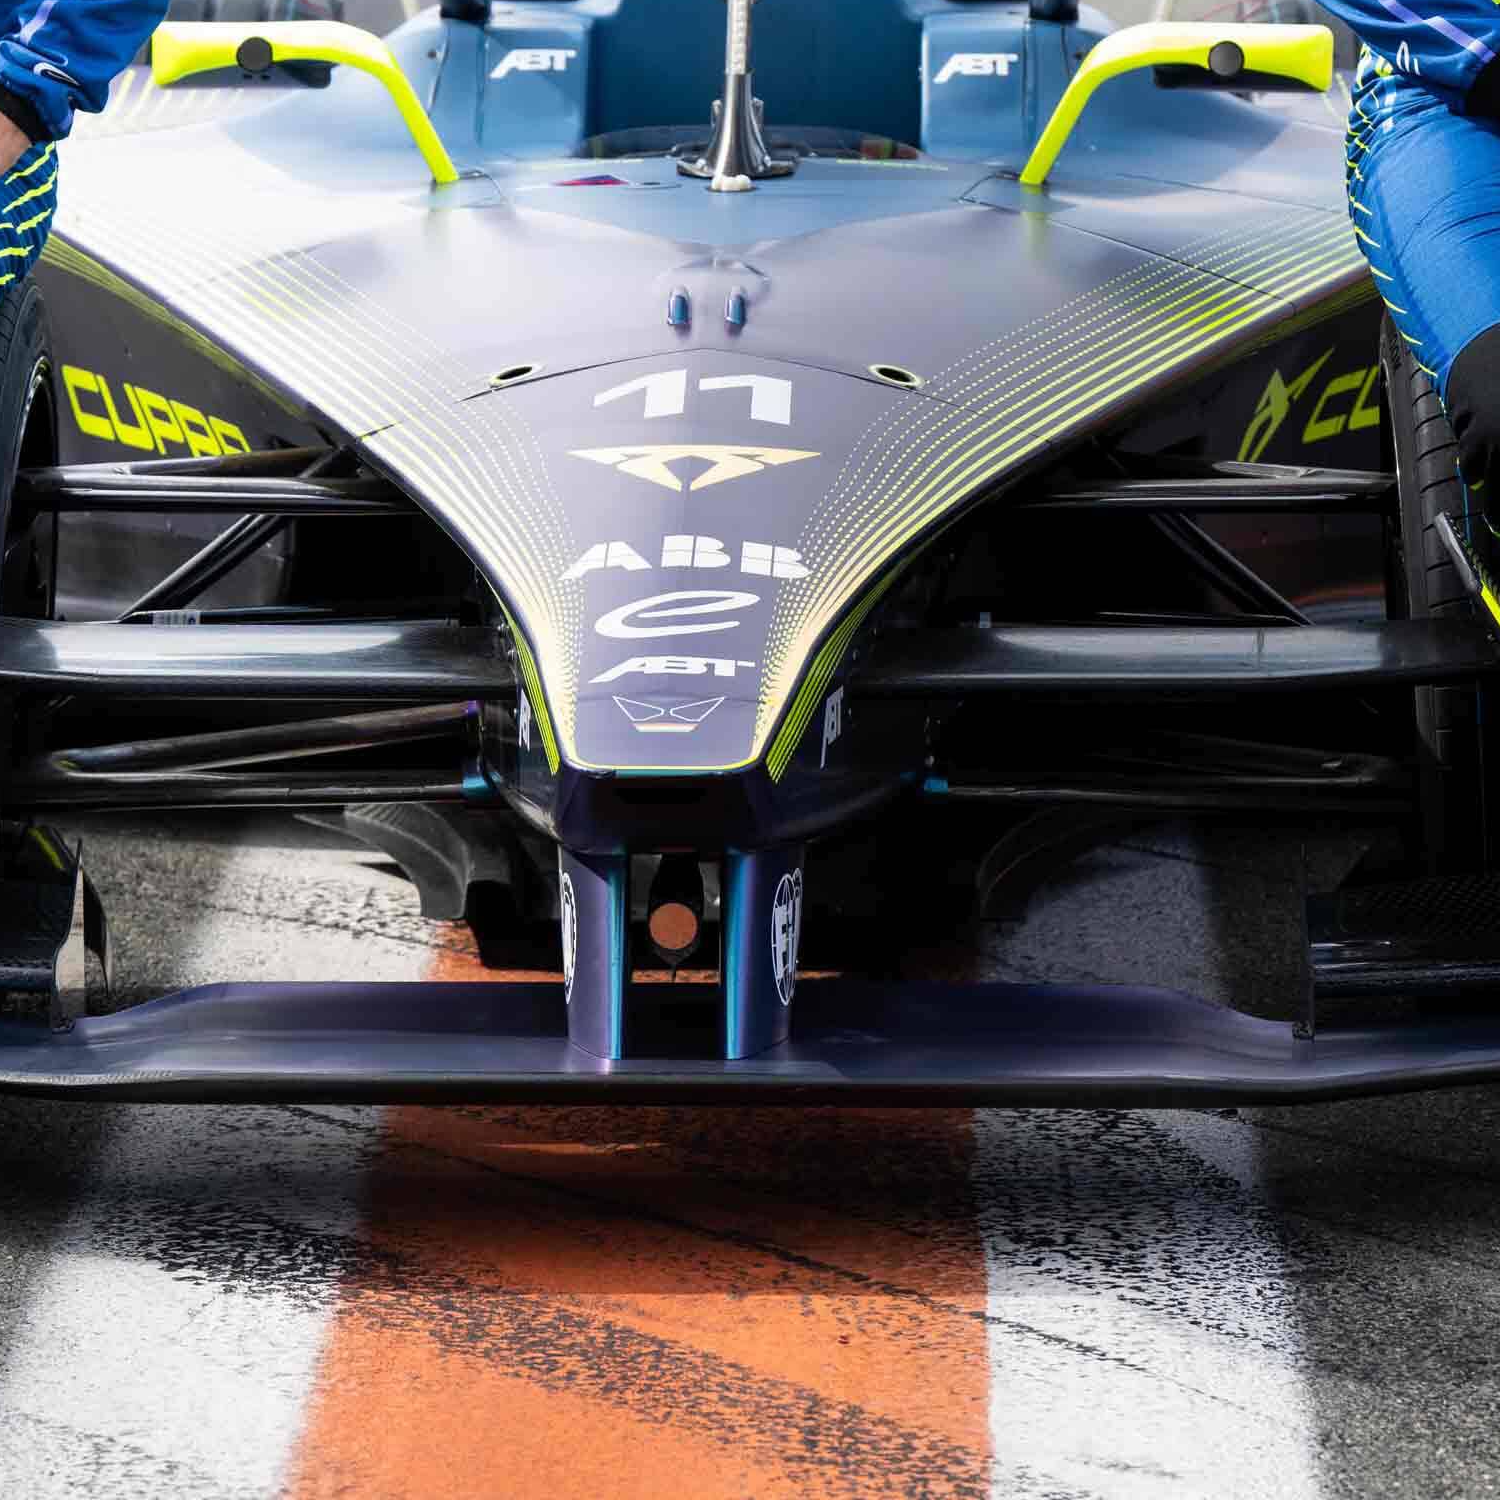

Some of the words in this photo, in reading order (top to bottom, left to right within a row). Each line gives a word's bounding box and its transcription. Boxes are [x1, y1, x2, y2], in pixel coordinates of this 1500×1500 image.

[489, 48, 577, 80] ABT
[933, 52, 1019, 85] ABT
[557, 534, 814, 580] ABB
[587, 655, 756, 684] ABT
